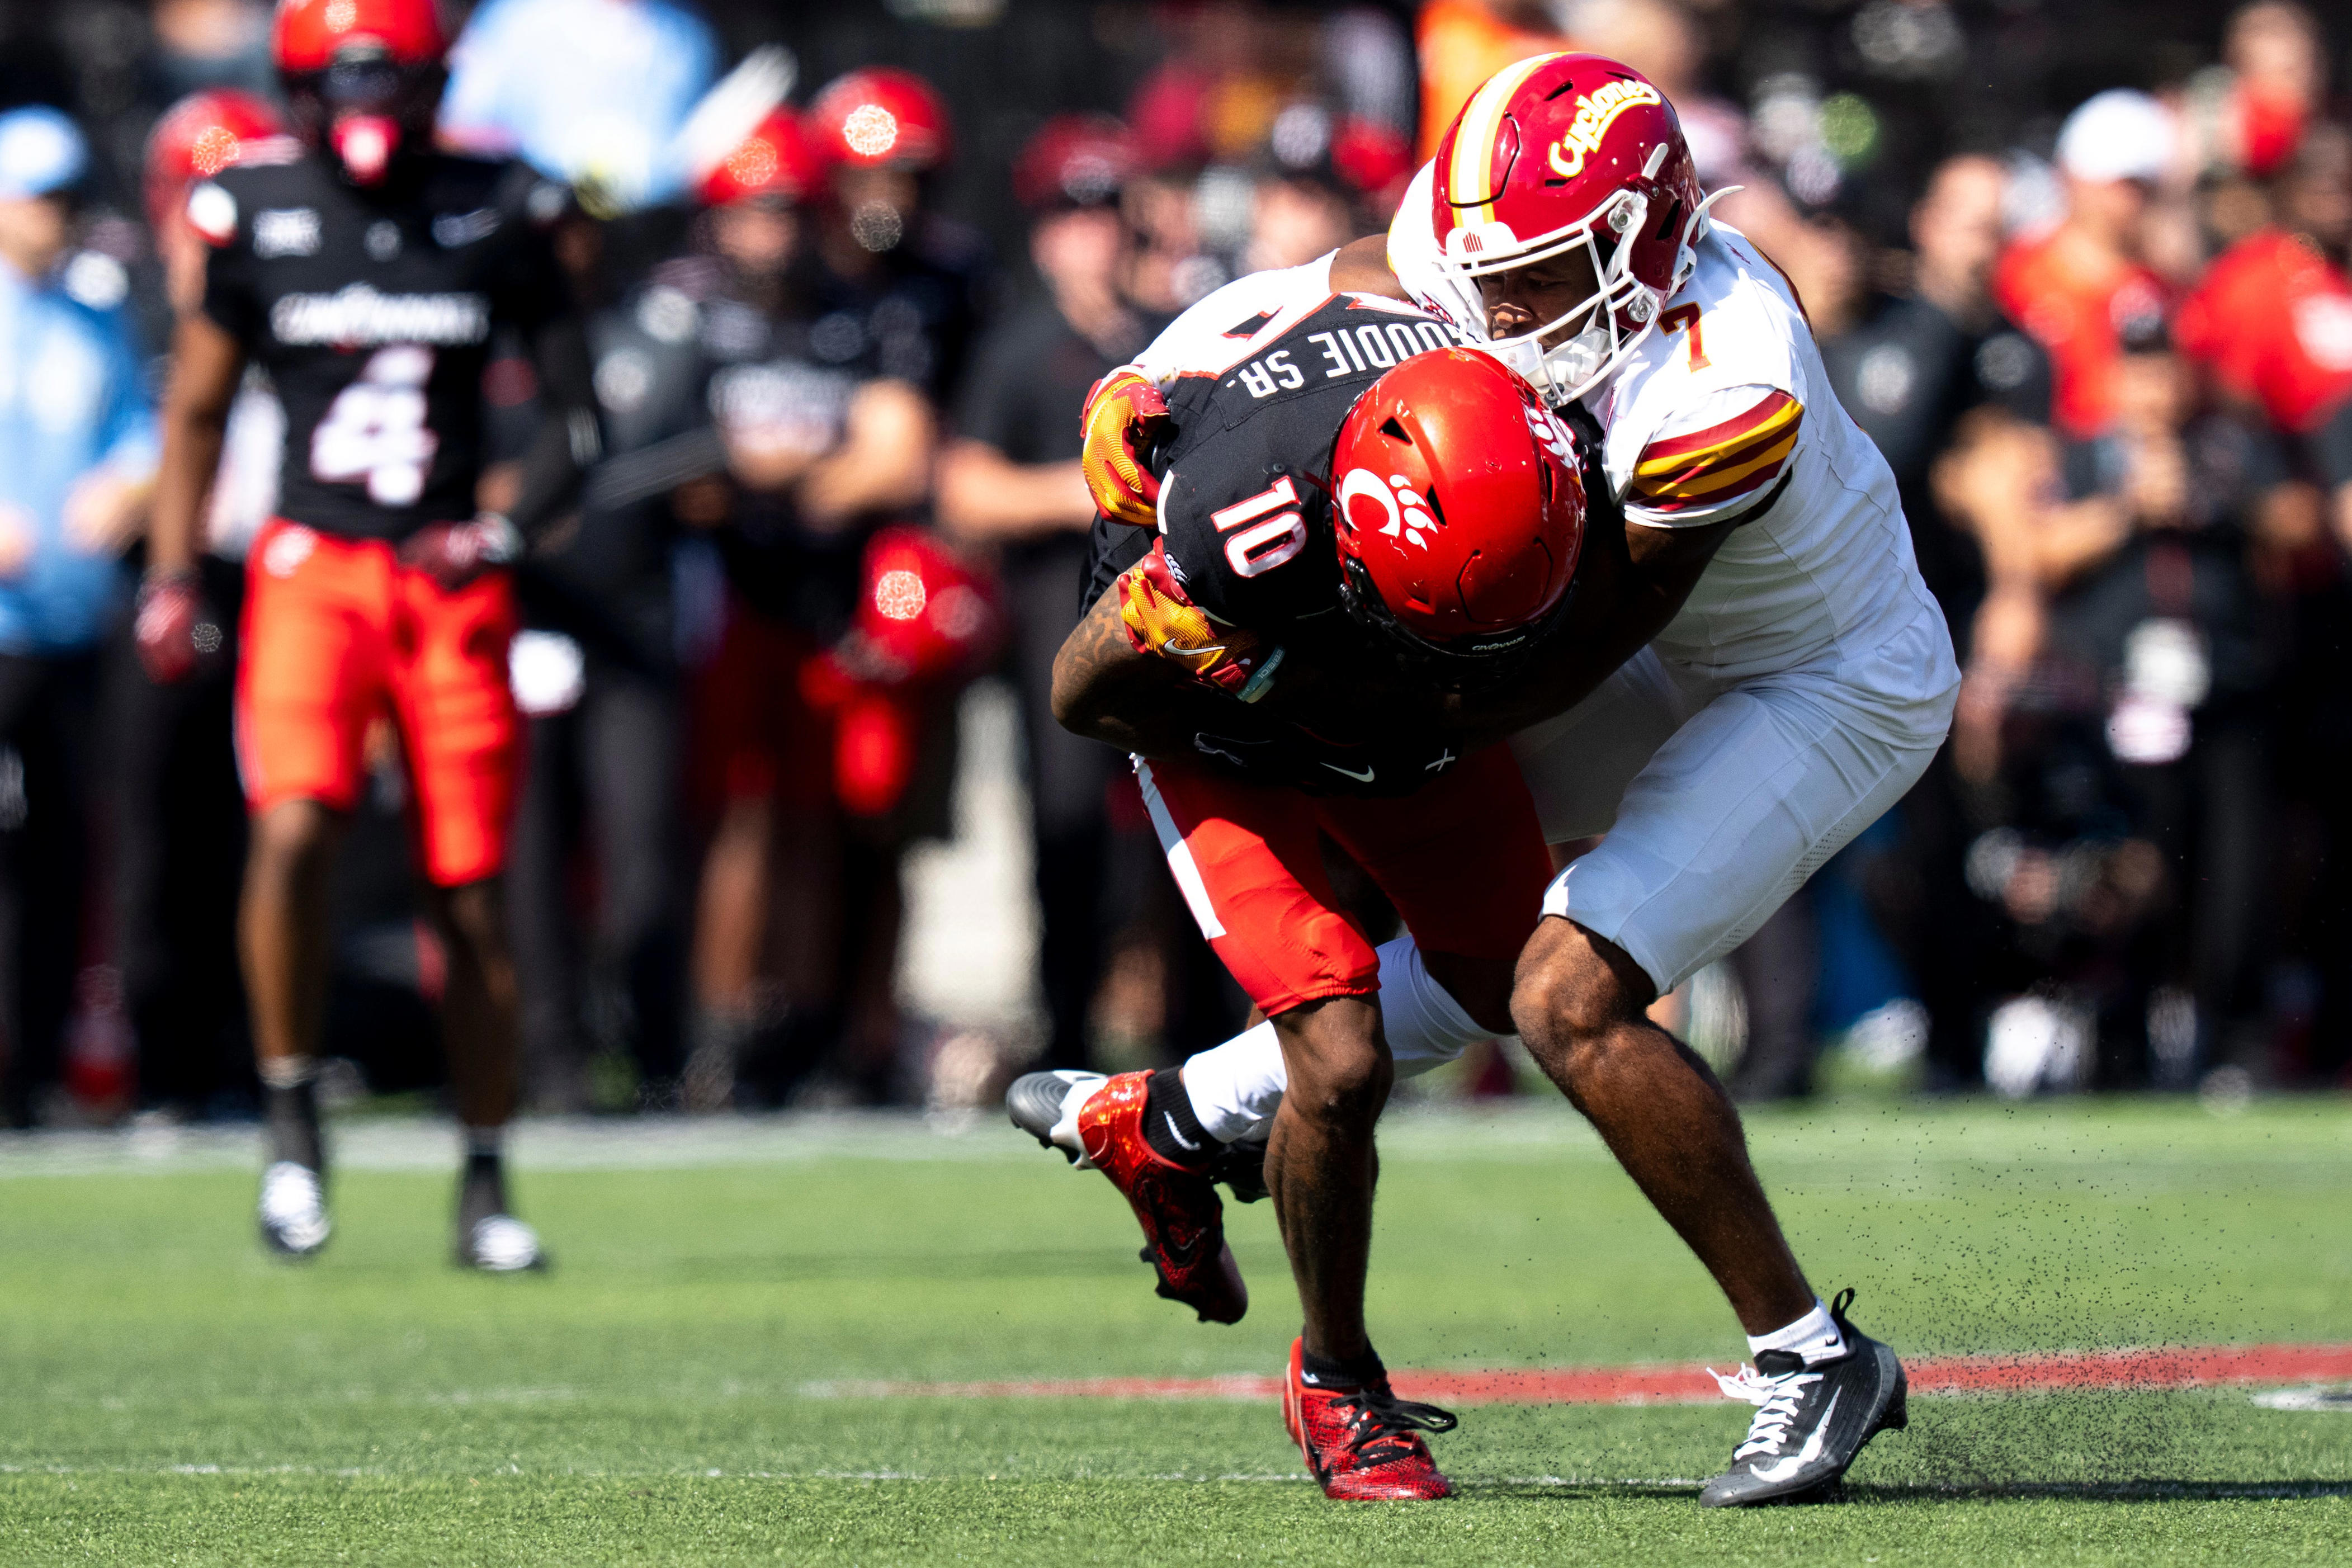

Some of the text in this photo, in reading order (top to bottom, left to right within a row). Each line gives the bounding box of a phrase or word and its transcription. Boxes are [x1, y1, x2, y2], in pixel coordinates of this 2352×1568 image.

[1548, 79, 1661, 177] Cyclones
[1226, 350, 1305, 398] SR.
[1657, 301, 1712, 374] 7
[309, 342, 441, 505] 4
[1210, 475, 1309, 579] 10
